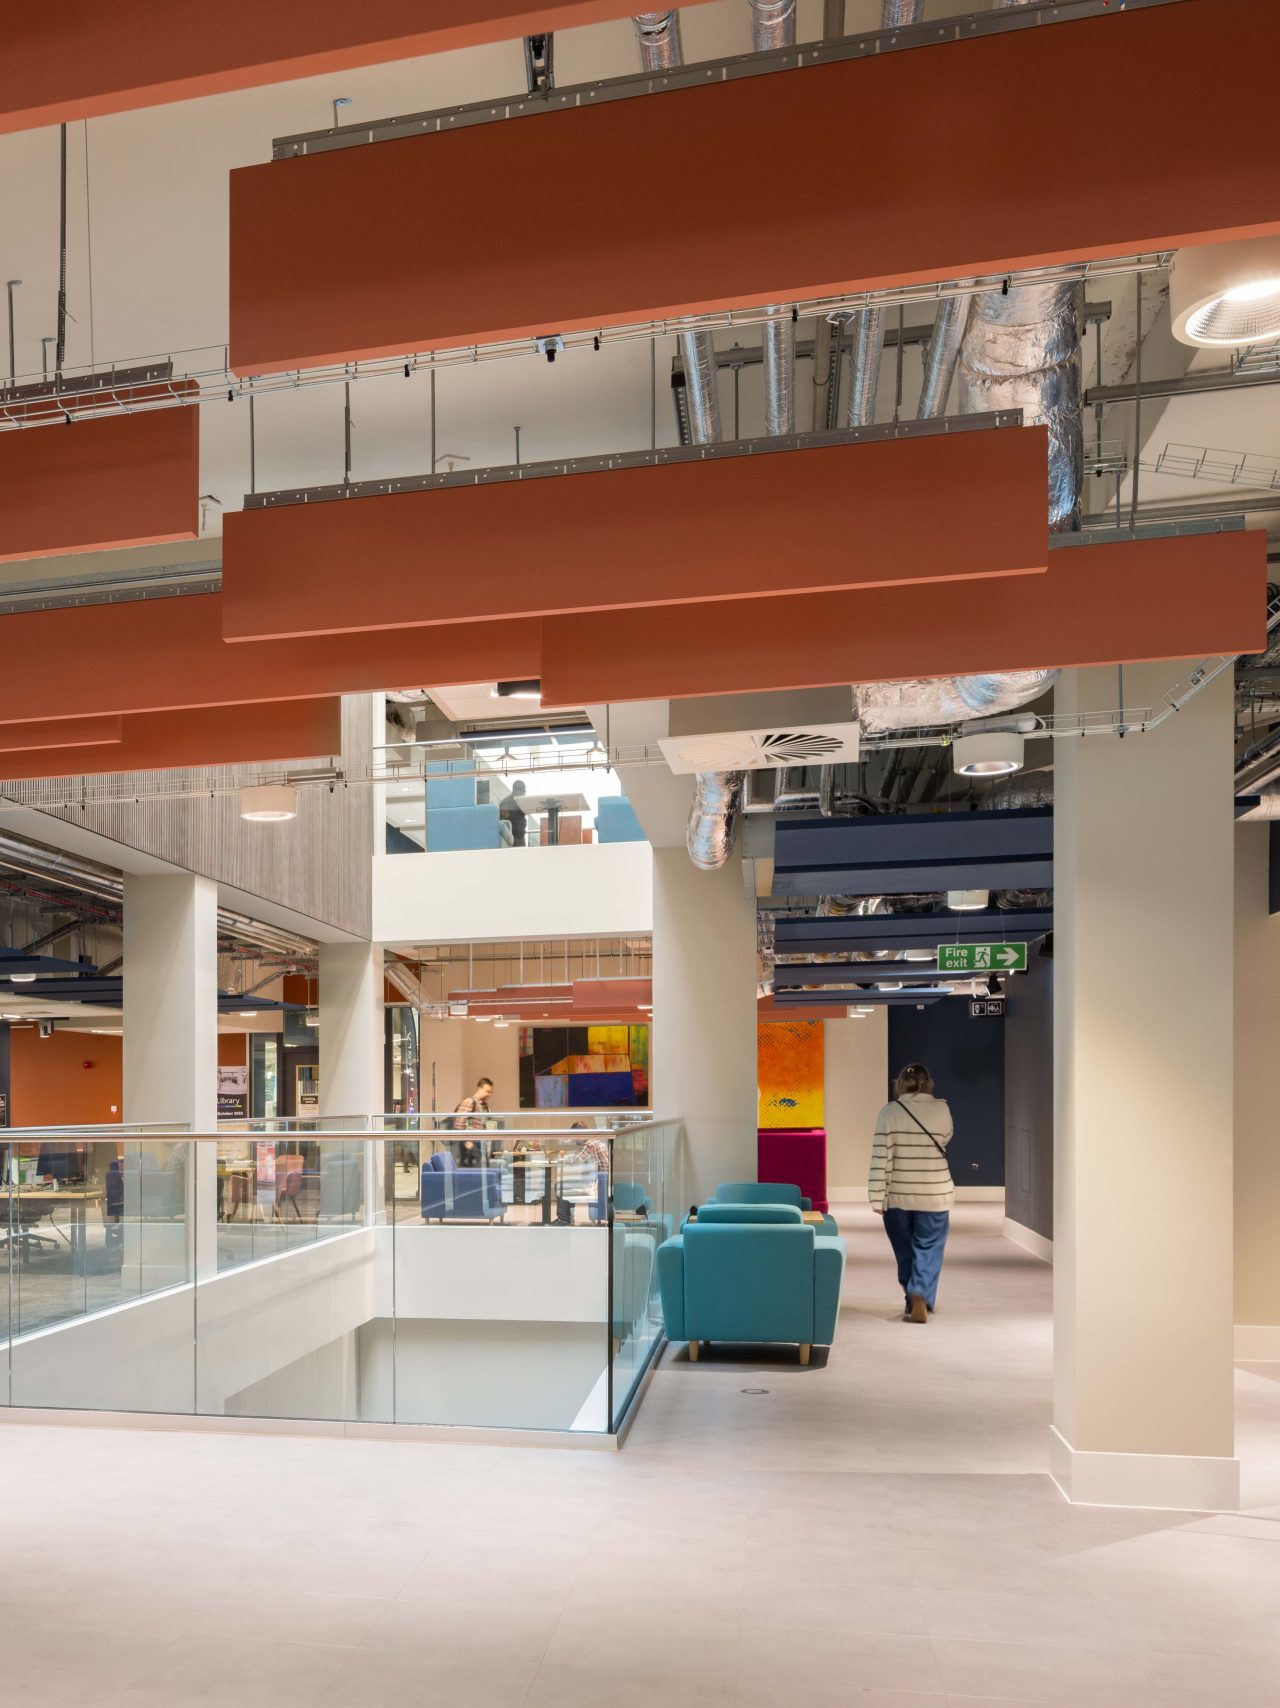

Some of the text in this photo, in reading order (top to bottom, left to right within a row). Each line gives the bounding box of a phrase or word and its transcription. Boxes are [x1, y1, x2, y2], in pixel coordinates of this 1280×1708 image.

[945, 947, 968, 957] Fire
[945, 958, 968, 968] exit
[217, 1098, 240, 1106] Library
